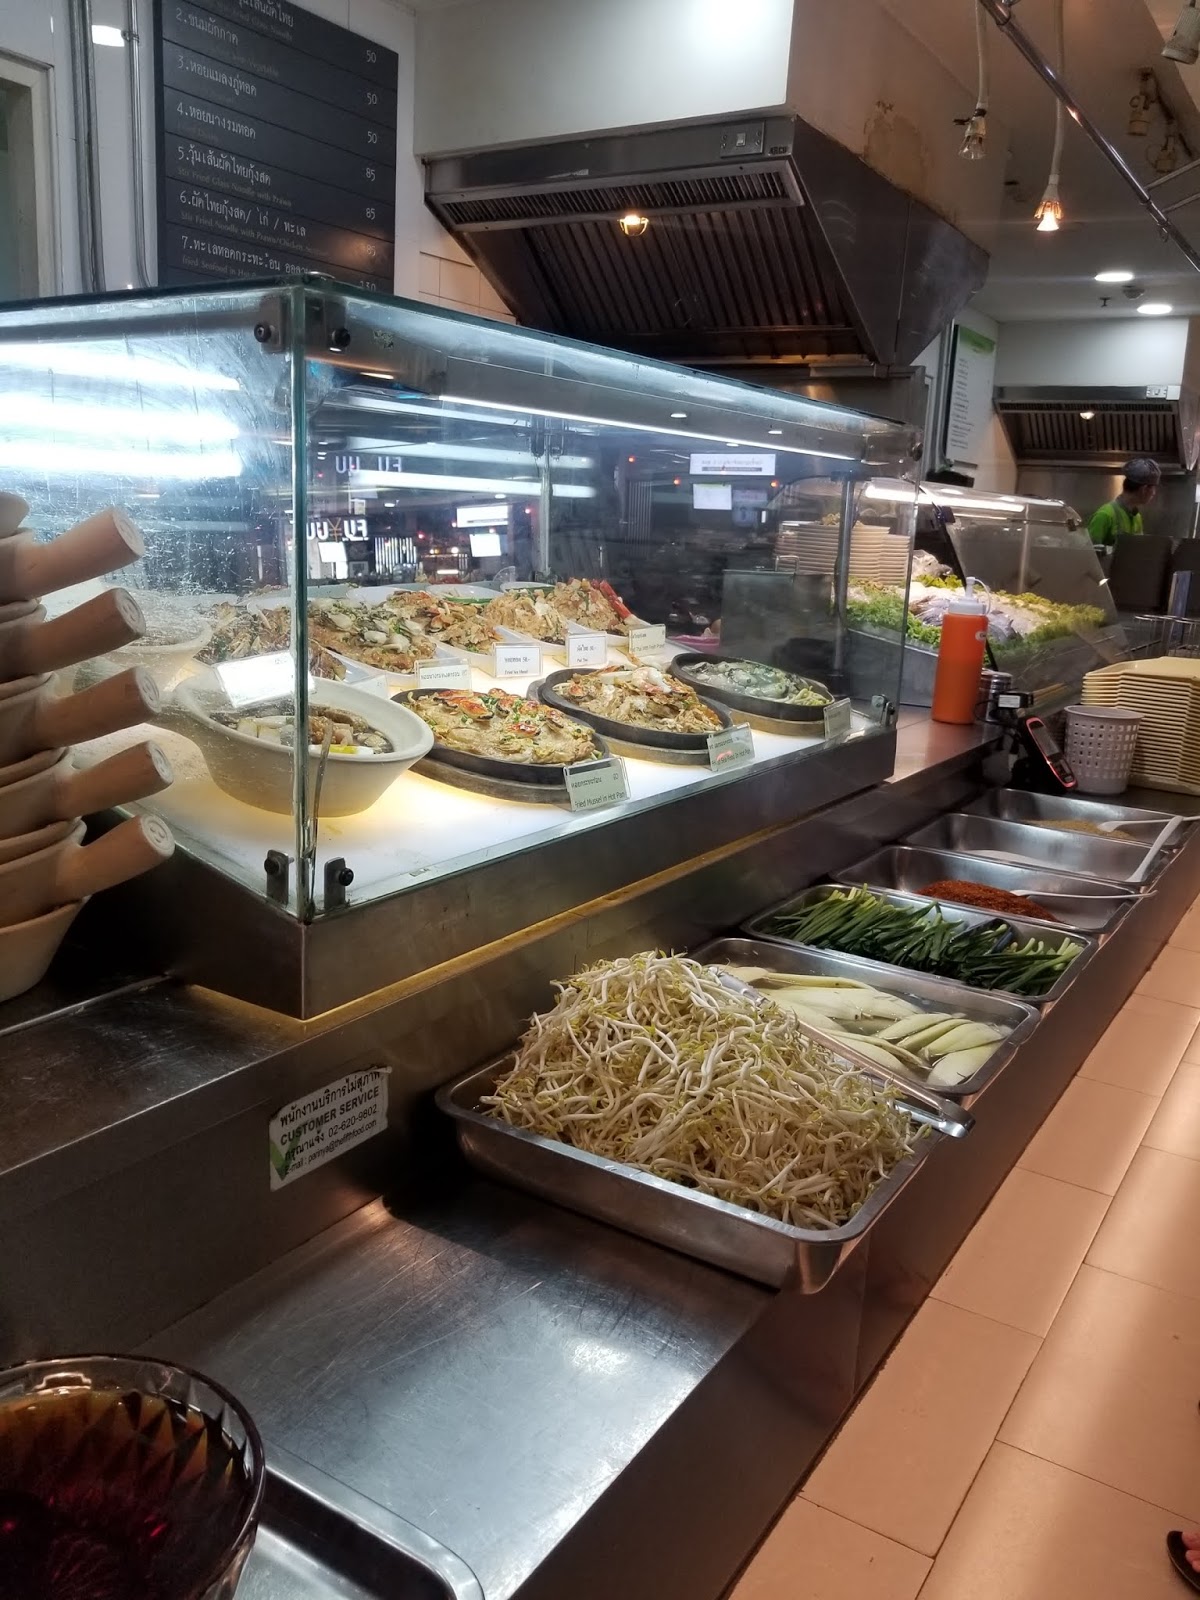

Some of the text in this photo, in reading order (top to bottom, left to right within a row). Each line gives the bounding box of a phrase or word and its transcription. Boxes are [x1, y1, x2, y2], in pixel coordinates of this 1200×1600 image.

[366, 51, 377, 63] 50
[367, 93, 378, 105] 50
[367, 132, 378, 144] 50
[365, 169, 376, 181] 85
[365, 208, 376, 220] 85
[366, 245, 376, 257] 85
[280, 1086, 380, 1146] CUSTOMER SERVICE
[285, 1104, 378, 1161] กรุณาแจ้ง 02-620-9802
